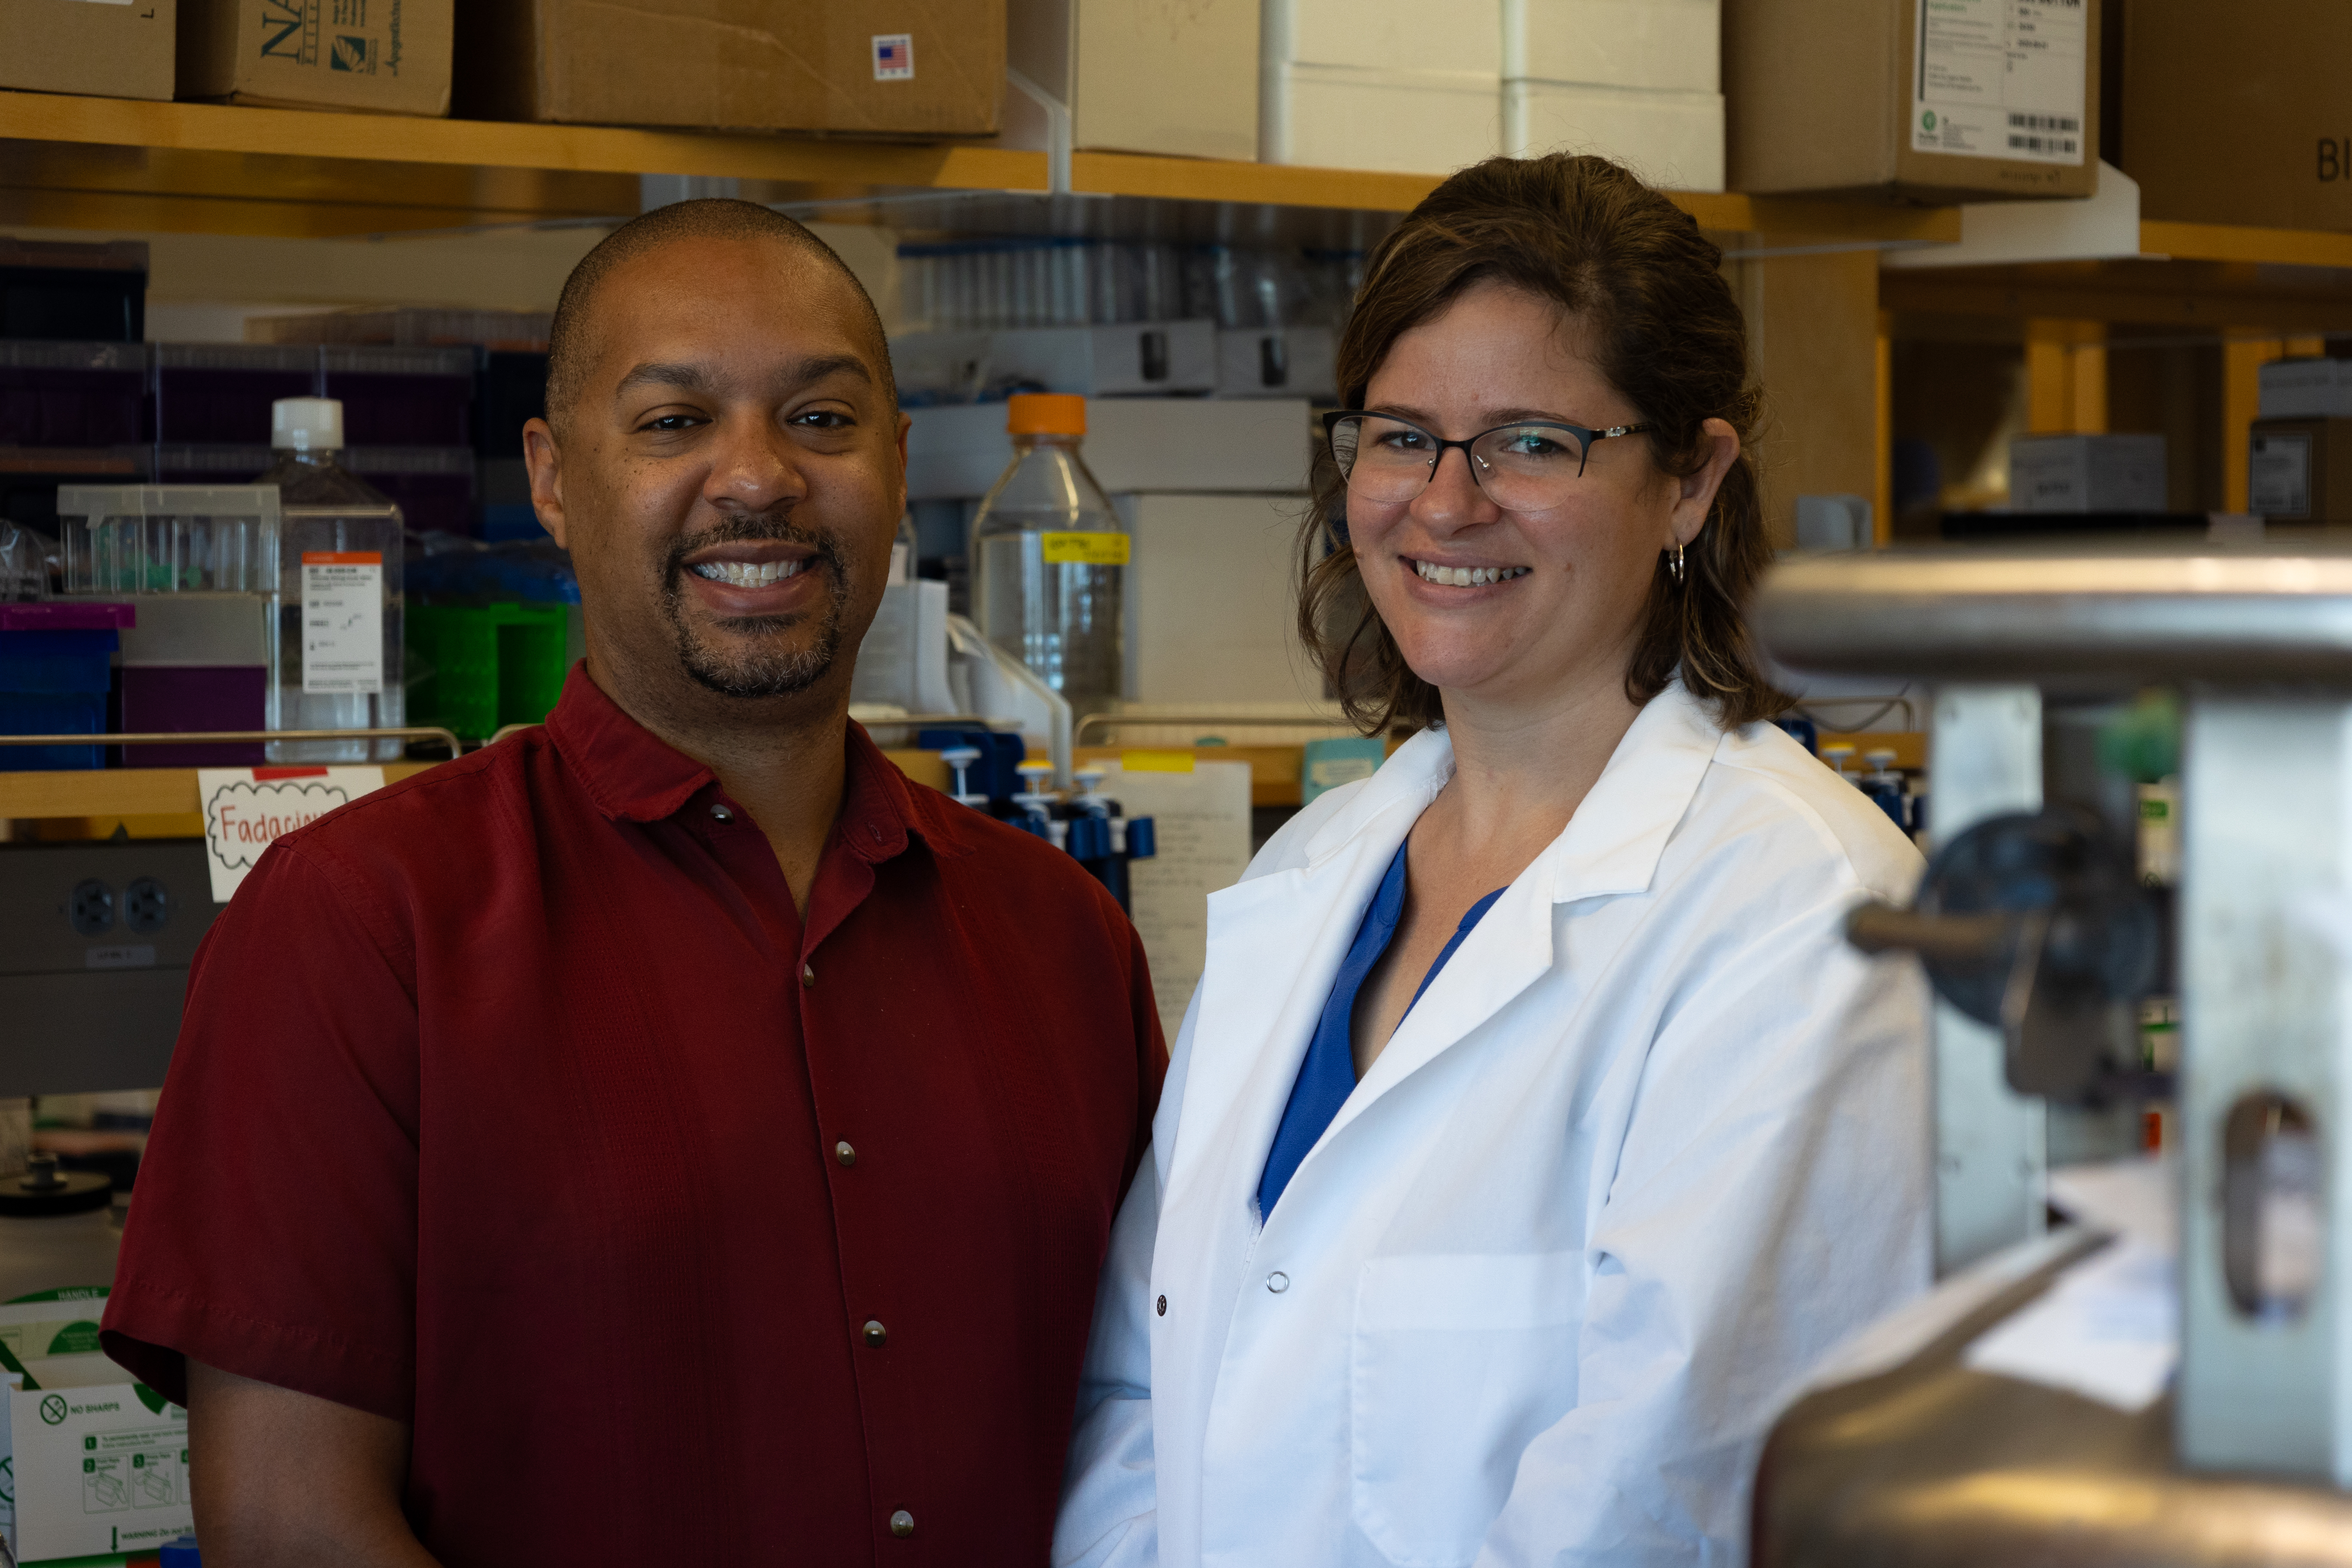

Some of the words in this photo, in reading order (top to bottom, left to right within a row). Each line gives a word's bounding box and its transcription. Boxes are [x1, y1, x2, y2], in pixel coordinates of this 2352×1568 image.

[57, 1288, 98, 1301] HANDLE
[70, 1405, 83, 1415] NO
[85, 1401, 120, 1414] SHARPS
